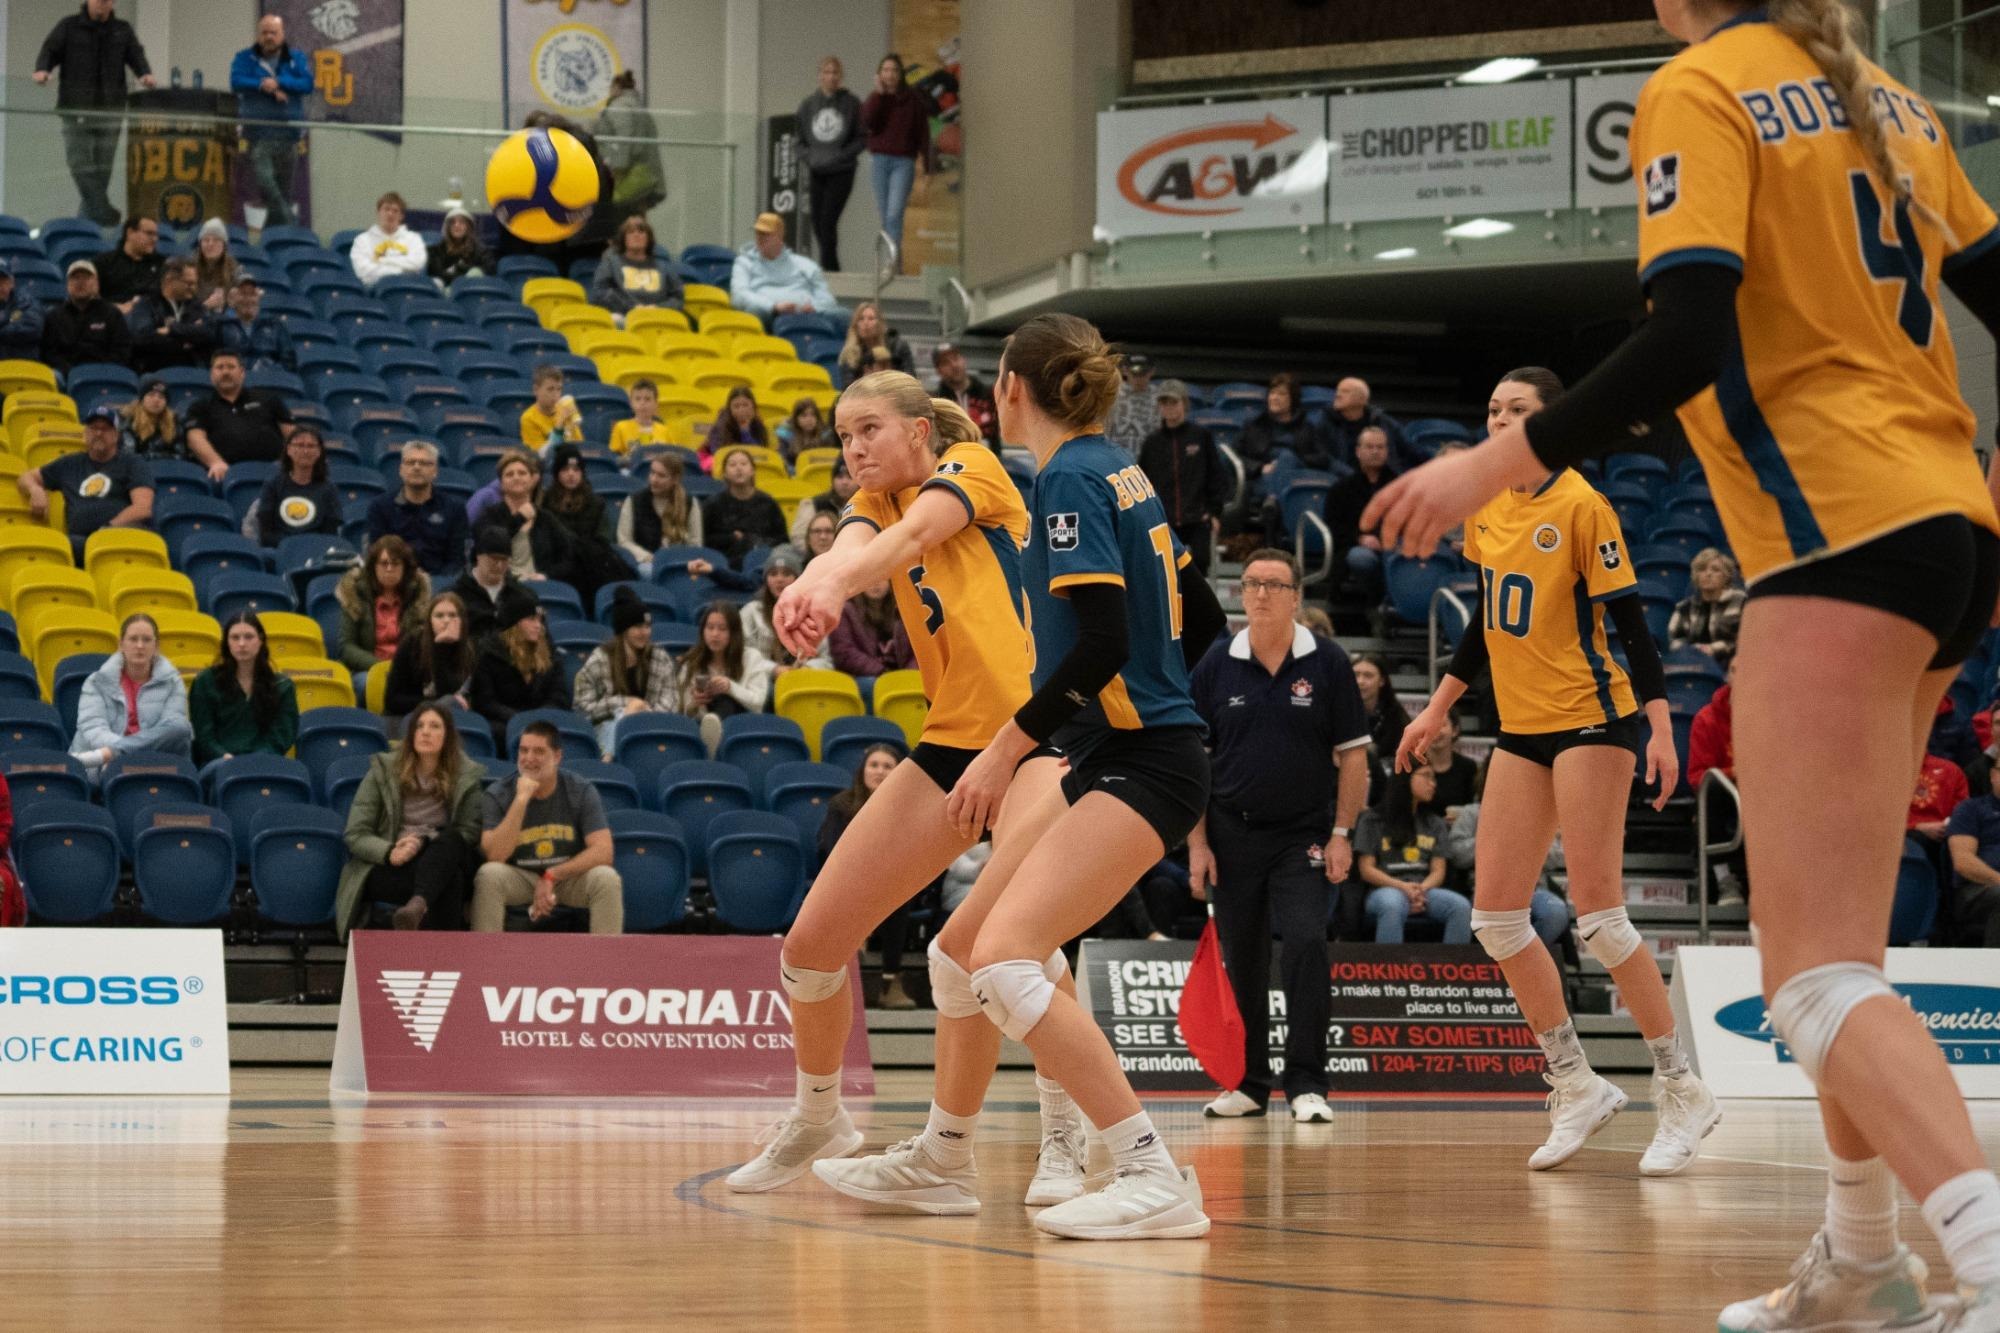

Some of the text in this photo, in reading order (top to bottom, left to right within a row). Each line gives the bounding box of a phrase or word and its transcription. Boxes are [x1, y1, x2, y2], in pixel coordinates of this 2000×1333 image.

[1145, 151, 1302, 203] A&W
[1849, 171, 1933, 348] 4
[1049, 527, 1078, 539] SPORTS
[1484, 567, 1534, 639] 10
[1122, 960, 1194, 986] CRI
[1429, 963, 1502, 981] TOGET
[1108, 960, 1127, 1015] BRANDON
[1343, 985, 1381, 997] make
[1383, 985, 1407, 997] the
[1410, 985, 1470, 997] Brandon
[1472, 987, 1502, 998] area
[480, 986, 793, 1026] VICTORIA IN
[1406, 1002, 1518, 1015] place to live and
[500, 1031, 794, 1049] HOTEL & CONVENTION CEN
[1114, 1024, 1168, 1045] SEE
[1351, 1026, 1399, 1045] SAY
[1407, 1026, 1540, 1046] SOMETHIN
[1382, 1055, 1504, 1073] 204-727-TIPS
[1508, 1055, 1546, 1077] (847
